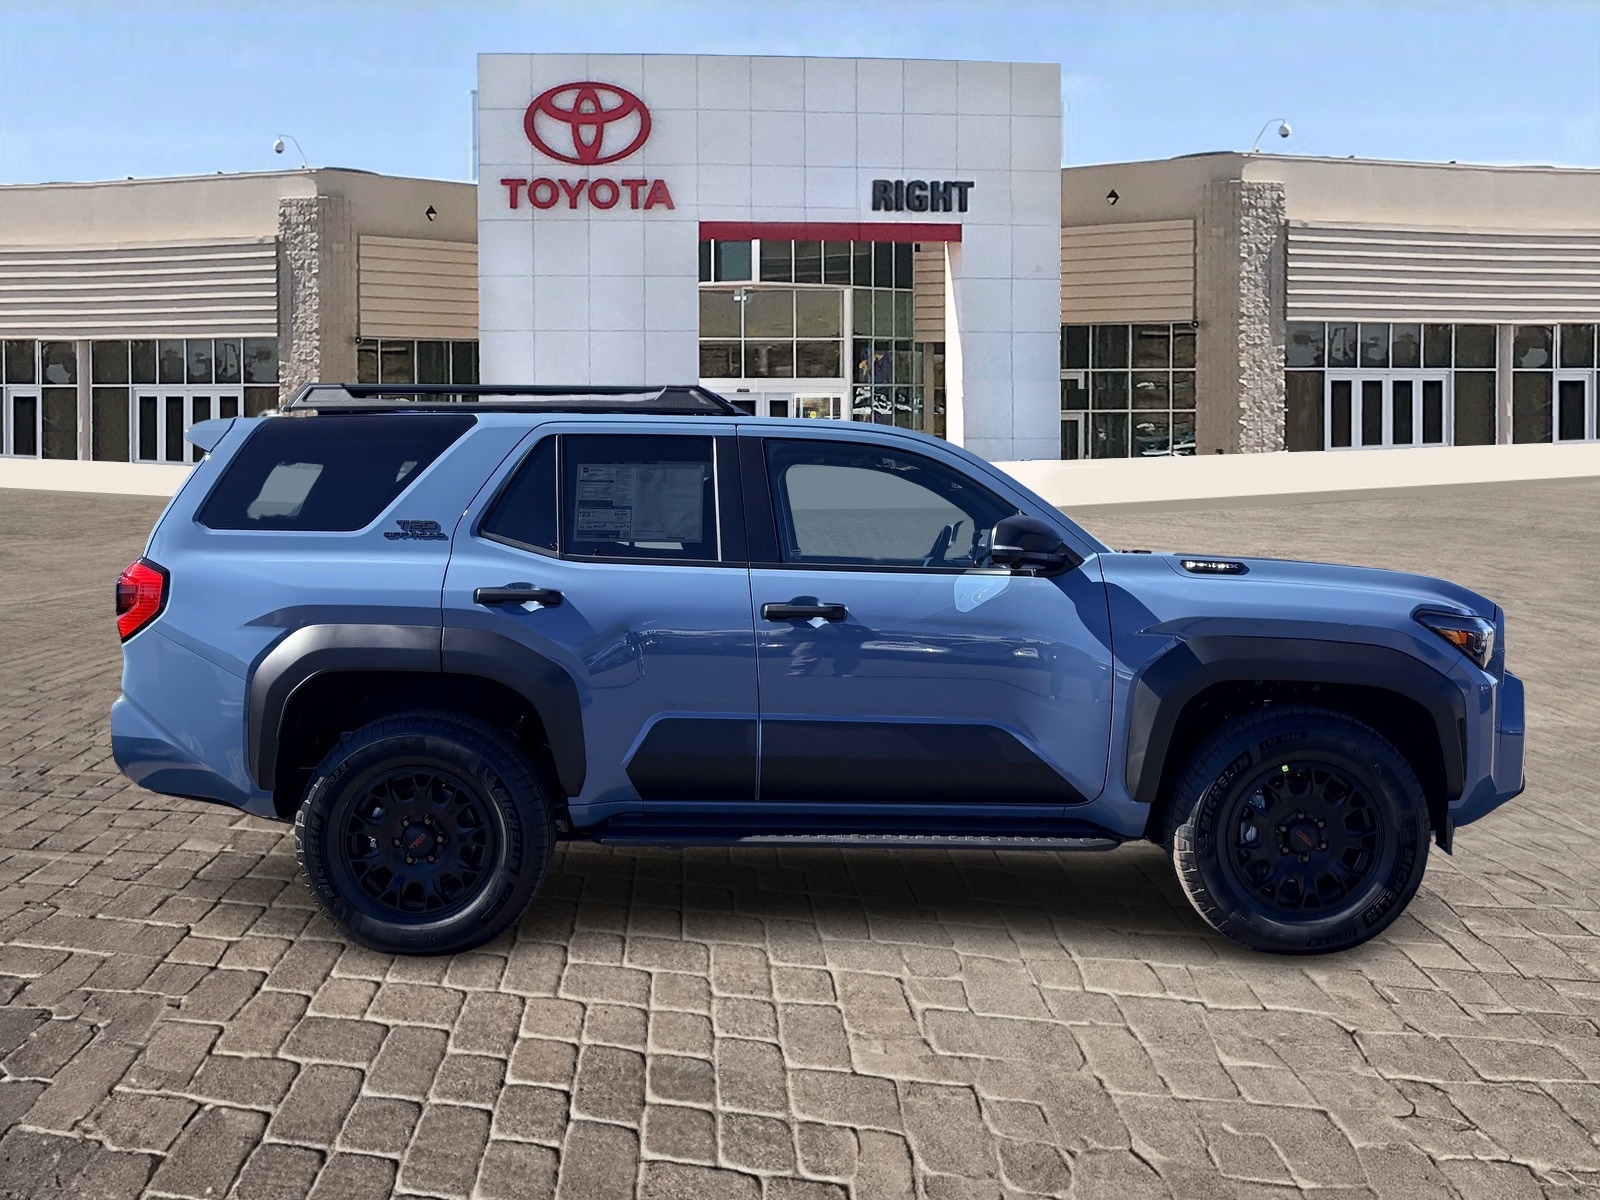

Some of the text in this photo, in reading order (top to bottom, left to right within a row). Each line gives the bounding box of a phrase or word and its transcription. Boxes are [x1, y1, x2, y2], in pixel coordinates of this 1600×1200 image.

[500, 178, 675, 210] TOYOTA
[872, 180, 975, 212] RIGHT
[396, 520, 441, 531] TRD
[1200, 752, 1250, 831] MICHELIN
[494, 787, 523, 872] MICHELIN
[1365, 846, 1414, 924] MICHELIN
